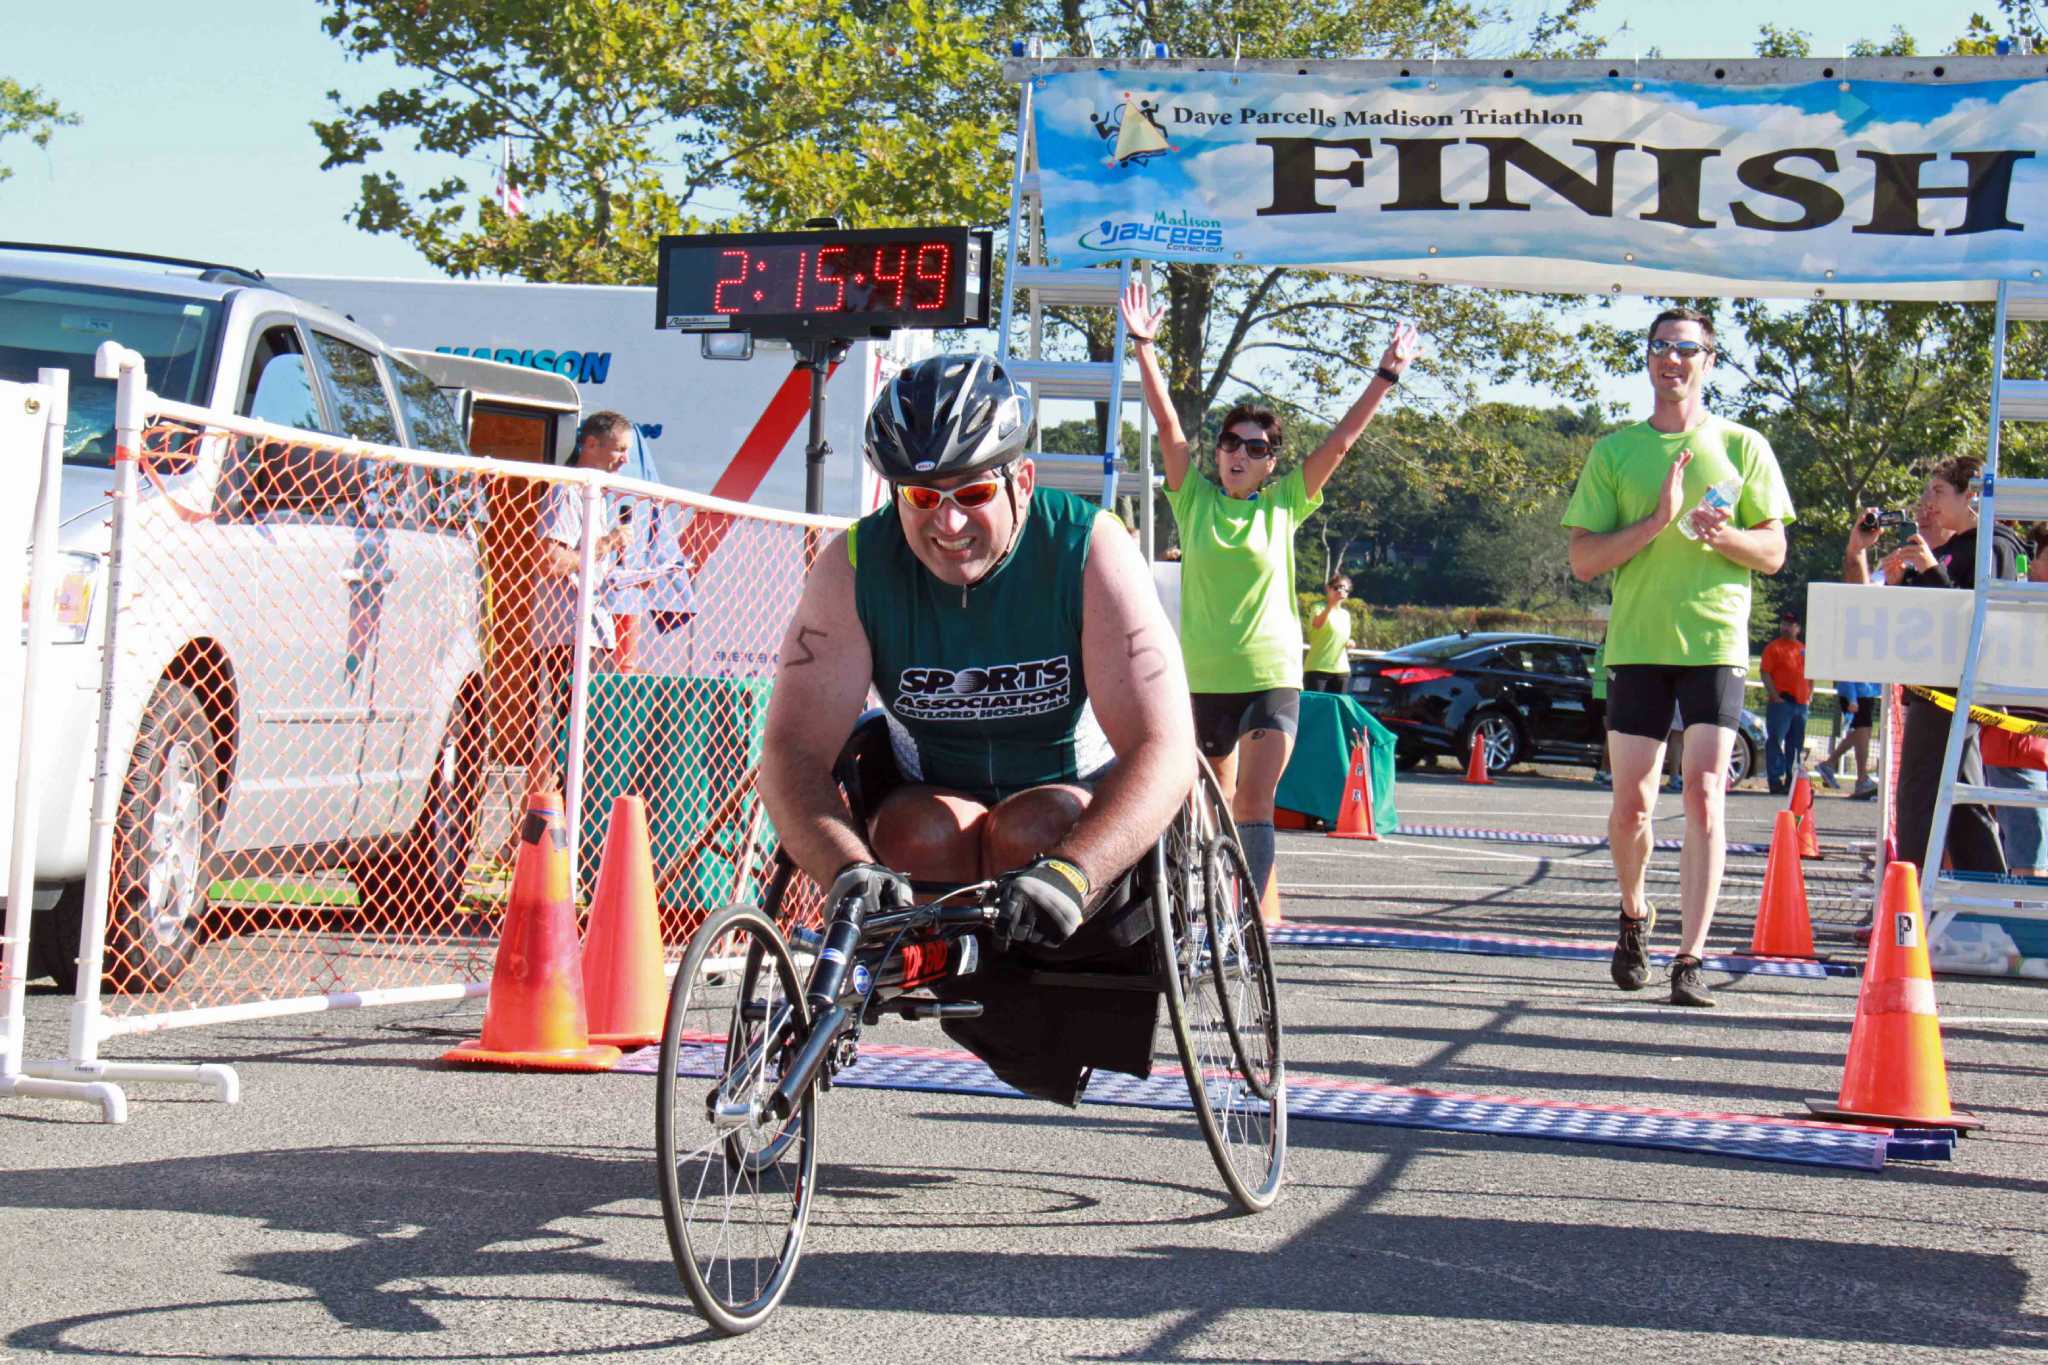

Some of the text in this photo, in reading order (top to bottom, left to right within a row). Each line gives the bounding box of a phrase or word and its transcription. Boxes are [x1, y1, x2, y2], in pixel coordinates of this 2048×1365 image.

[1173, 107, 1584, 127] Dave Parcells Madison Triathlon
[1256, 136, 2036, 237] FINISH
[1153, 209, 1222, 228] Madison
[435, 347, 612, 384] ISON
[1126, 627, 1169, 682] 5
[899, 655, 1071, 696] SPORTS
[899, 683, 1069, 711] ASSOCIATION
[979, 699, 1070, 719] HOSPITAL
[1898, 915, 1912, 945] P
